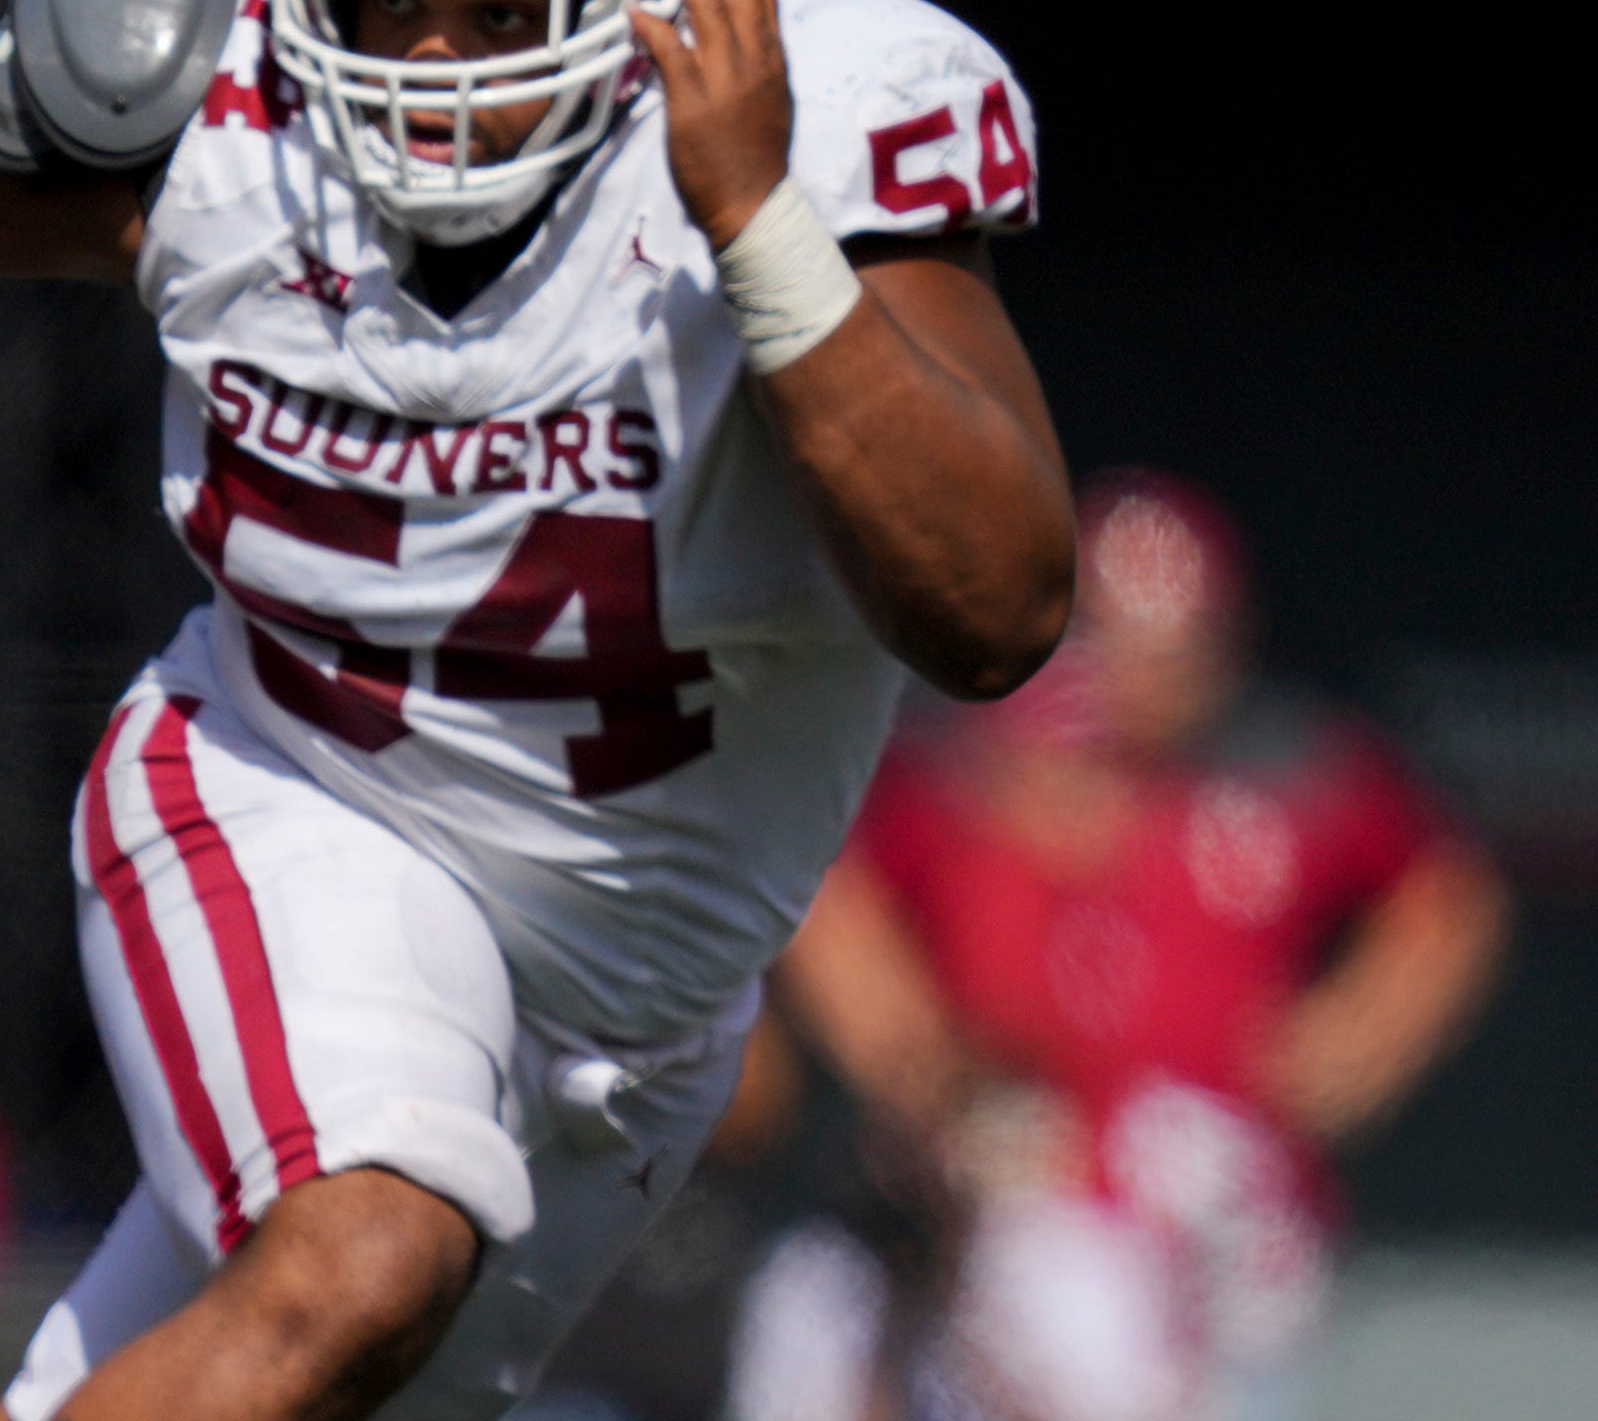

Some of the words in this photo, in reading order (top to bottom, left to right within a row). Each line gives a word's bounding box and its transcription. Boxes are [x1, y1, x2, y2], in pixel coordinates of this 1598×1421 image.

[866, 78, 1031, 232] 54
[209, 358, 662, 496] SOONERS
[185, 430, 717, 800] 54
